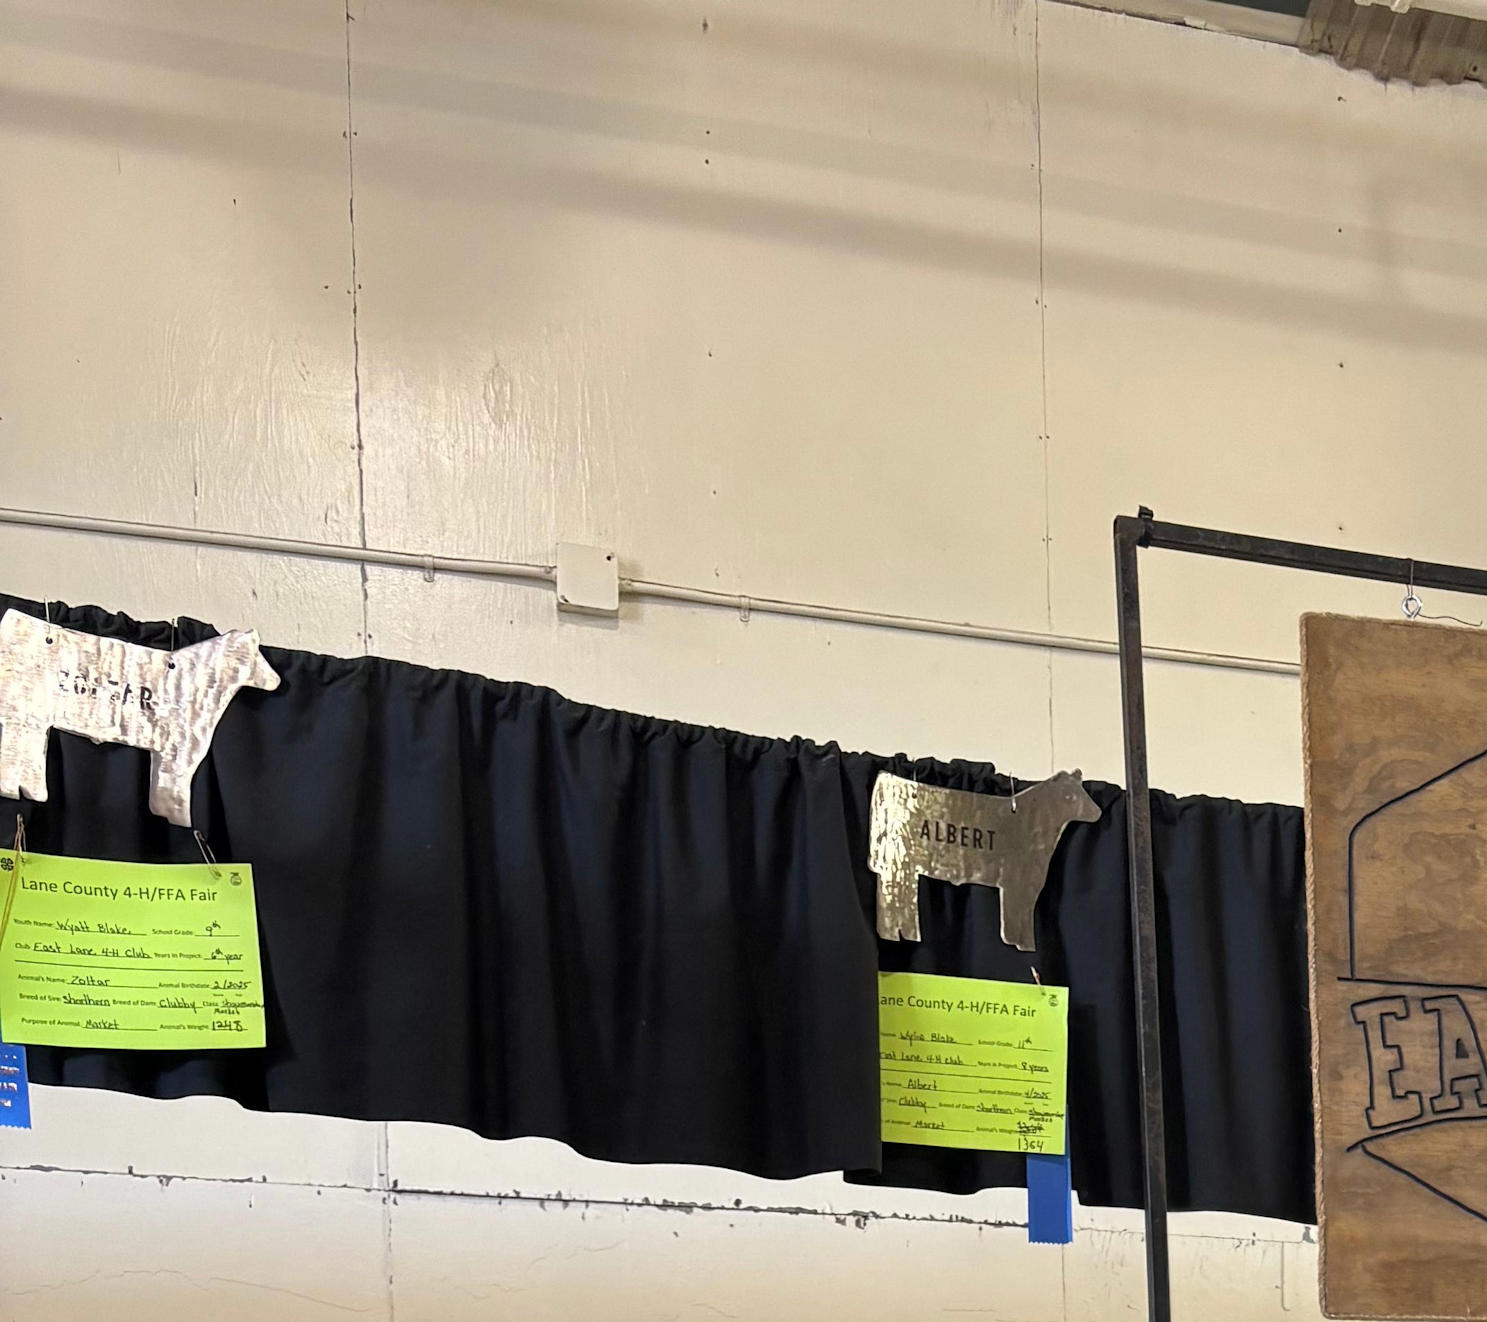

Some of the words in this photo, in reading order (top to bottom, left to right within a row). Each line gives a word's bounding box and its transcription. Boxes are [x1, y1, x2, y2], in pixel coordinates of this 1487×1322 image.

[919, 819, 997, 851] ALBERT
[21, 876, 58, 893] Lane
[62, 881, 119, 901] County
[122, 885, 186, 902] 4-H/FFA
[189, 888, 218, 902] Fair
[56, 918, 91, 936] Wyatt
[32, 941, 62, 954] East
[124, 946, 152, 959] Club
[223, 953, 244, 966] year
[69, 975, 111, 988] Zoltar
[880, 996, 904, 1007] ane
[907, 995, 953, 1013] County
[957, 1000, 1009, 1016] 4-H/FFA
[1013, 1004, 1037, 1018] Fair
[85, 1018, 120, 1031] Market
[907, 1078, 938, 1091] Albert
[1017, 1136, 1044, 1152] 1364
